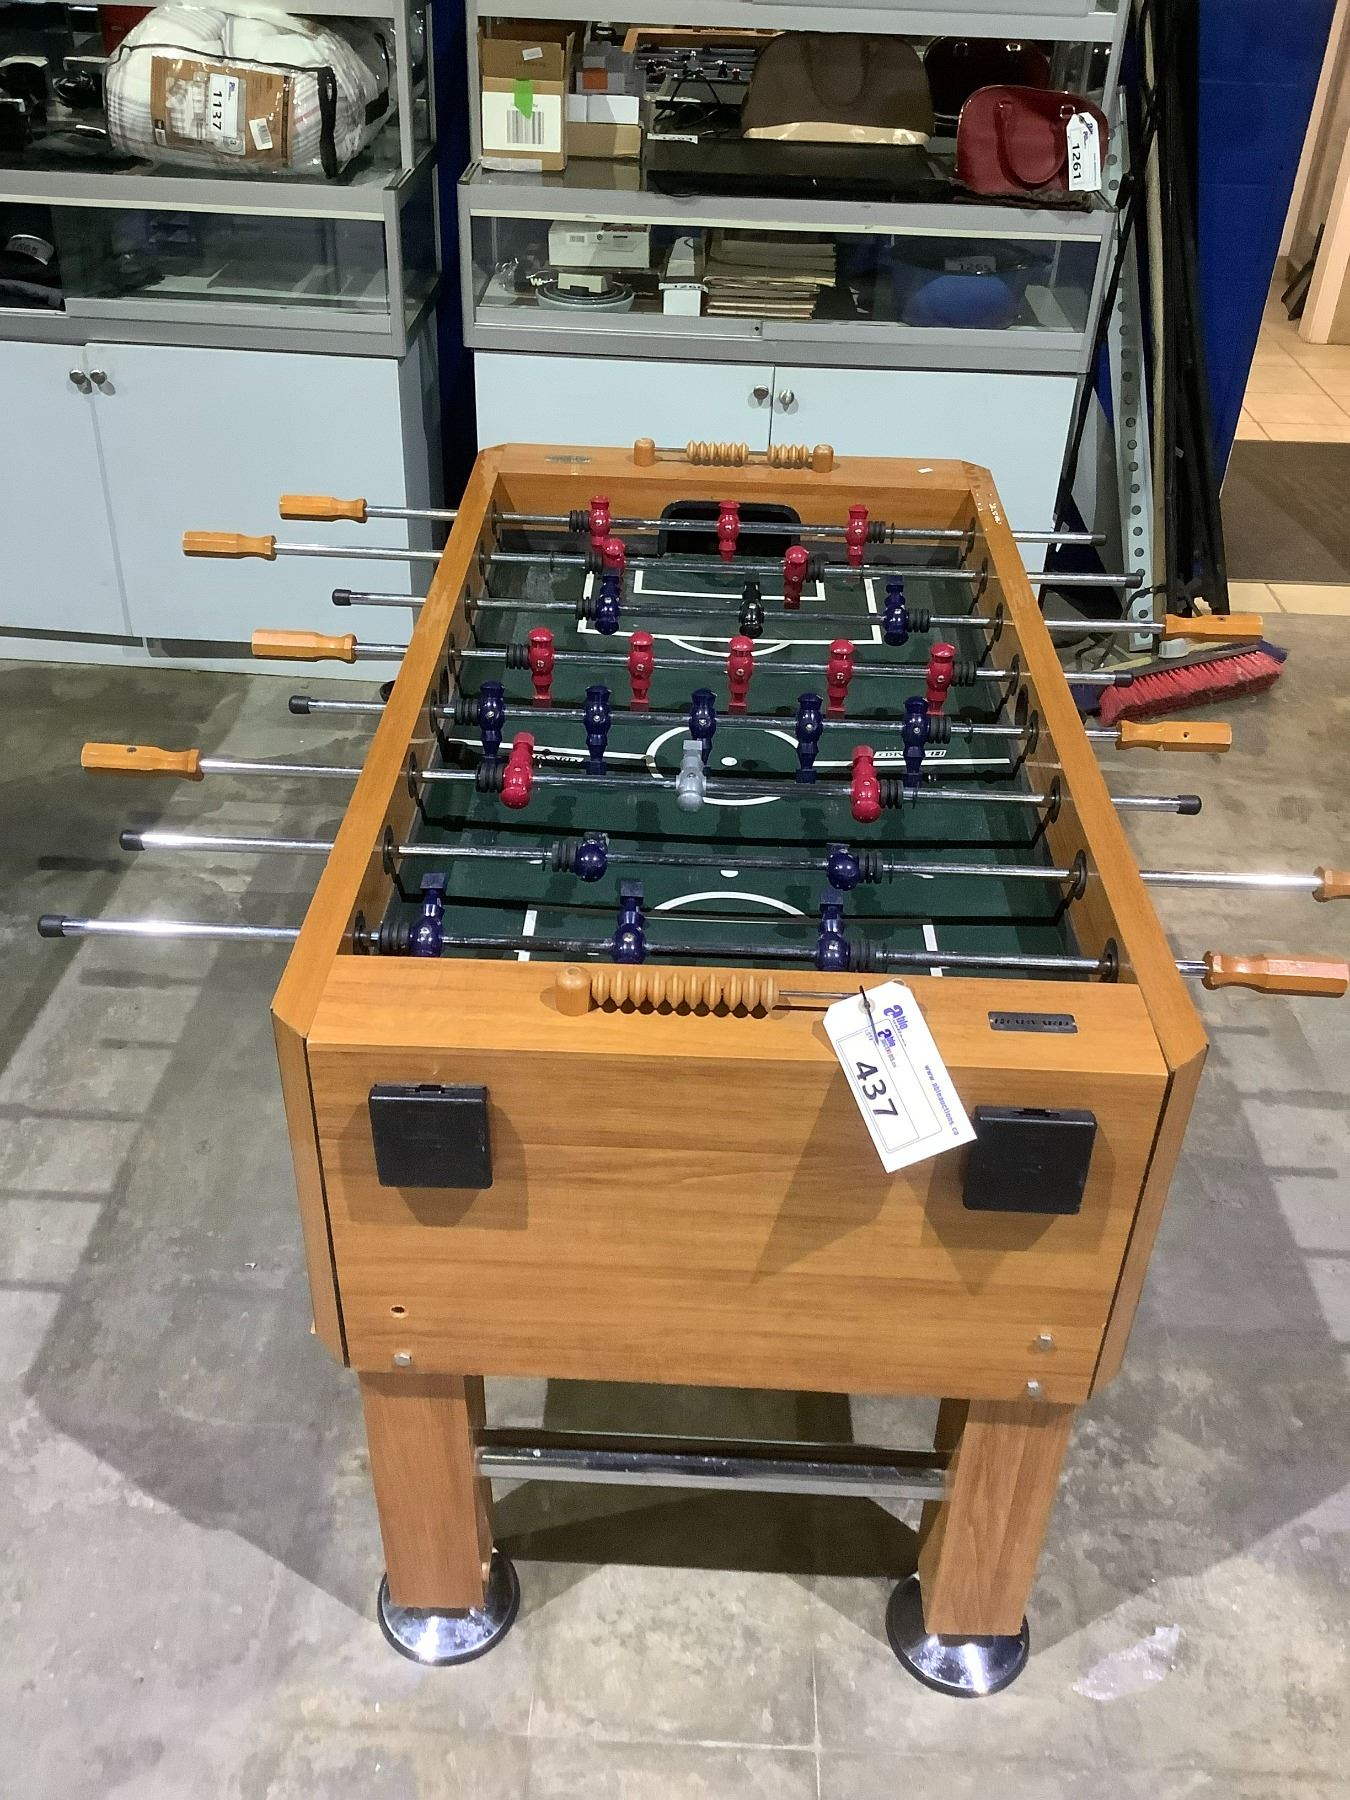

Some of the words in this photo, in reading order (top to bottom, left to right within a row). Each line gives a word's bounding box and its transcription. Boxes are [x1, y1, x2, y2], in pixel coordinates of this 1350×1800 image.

[212, 91, 223, 130] 1137
[1072, 143, 1082, 179] 1261
[856, 1061, 898, 1116] 437
[924, 1065, 959, 1136] www.ableauctions.ca
